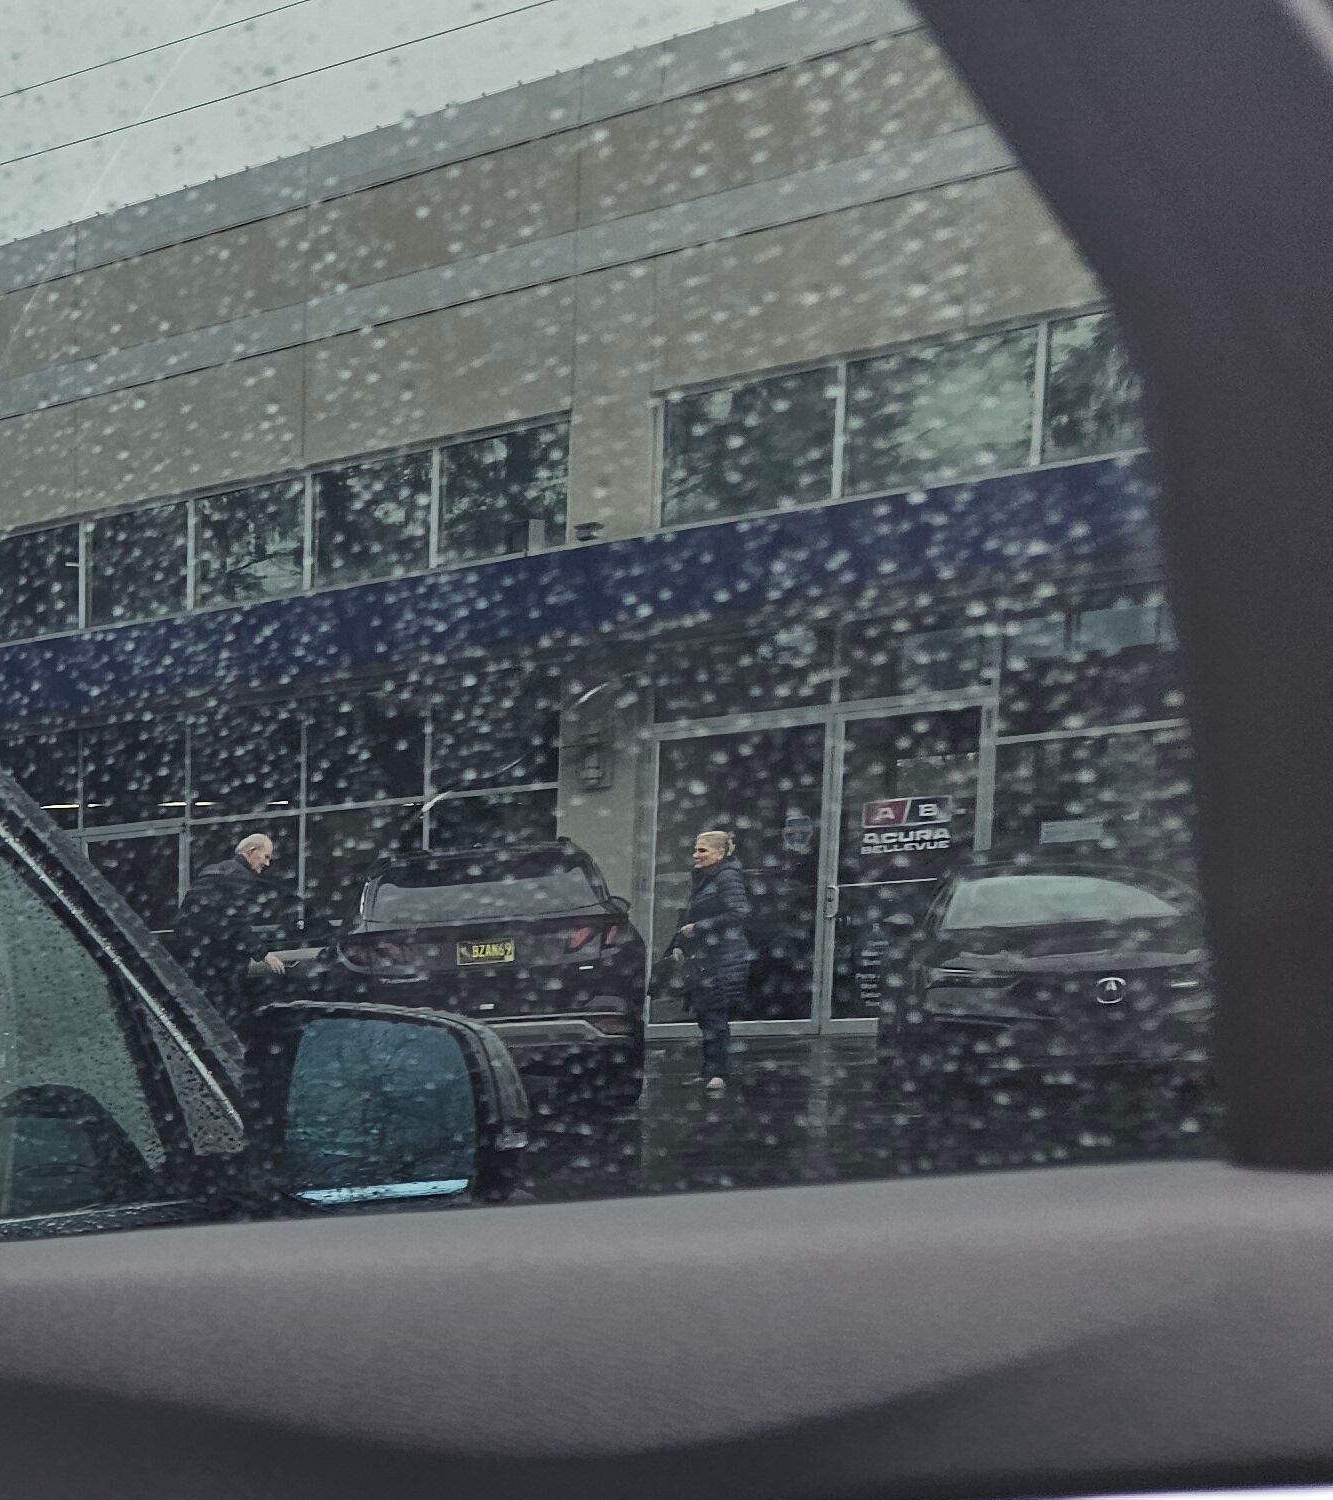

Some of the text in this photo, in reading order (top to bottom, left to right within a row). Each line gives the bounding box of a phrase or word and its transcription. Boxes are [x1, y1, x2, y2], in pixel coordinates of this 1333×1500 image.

[874, 803, 938, 820] A B
[862, 828, 951, 844] ACURA
[860, 841, 950, 855] BELLEVUE
